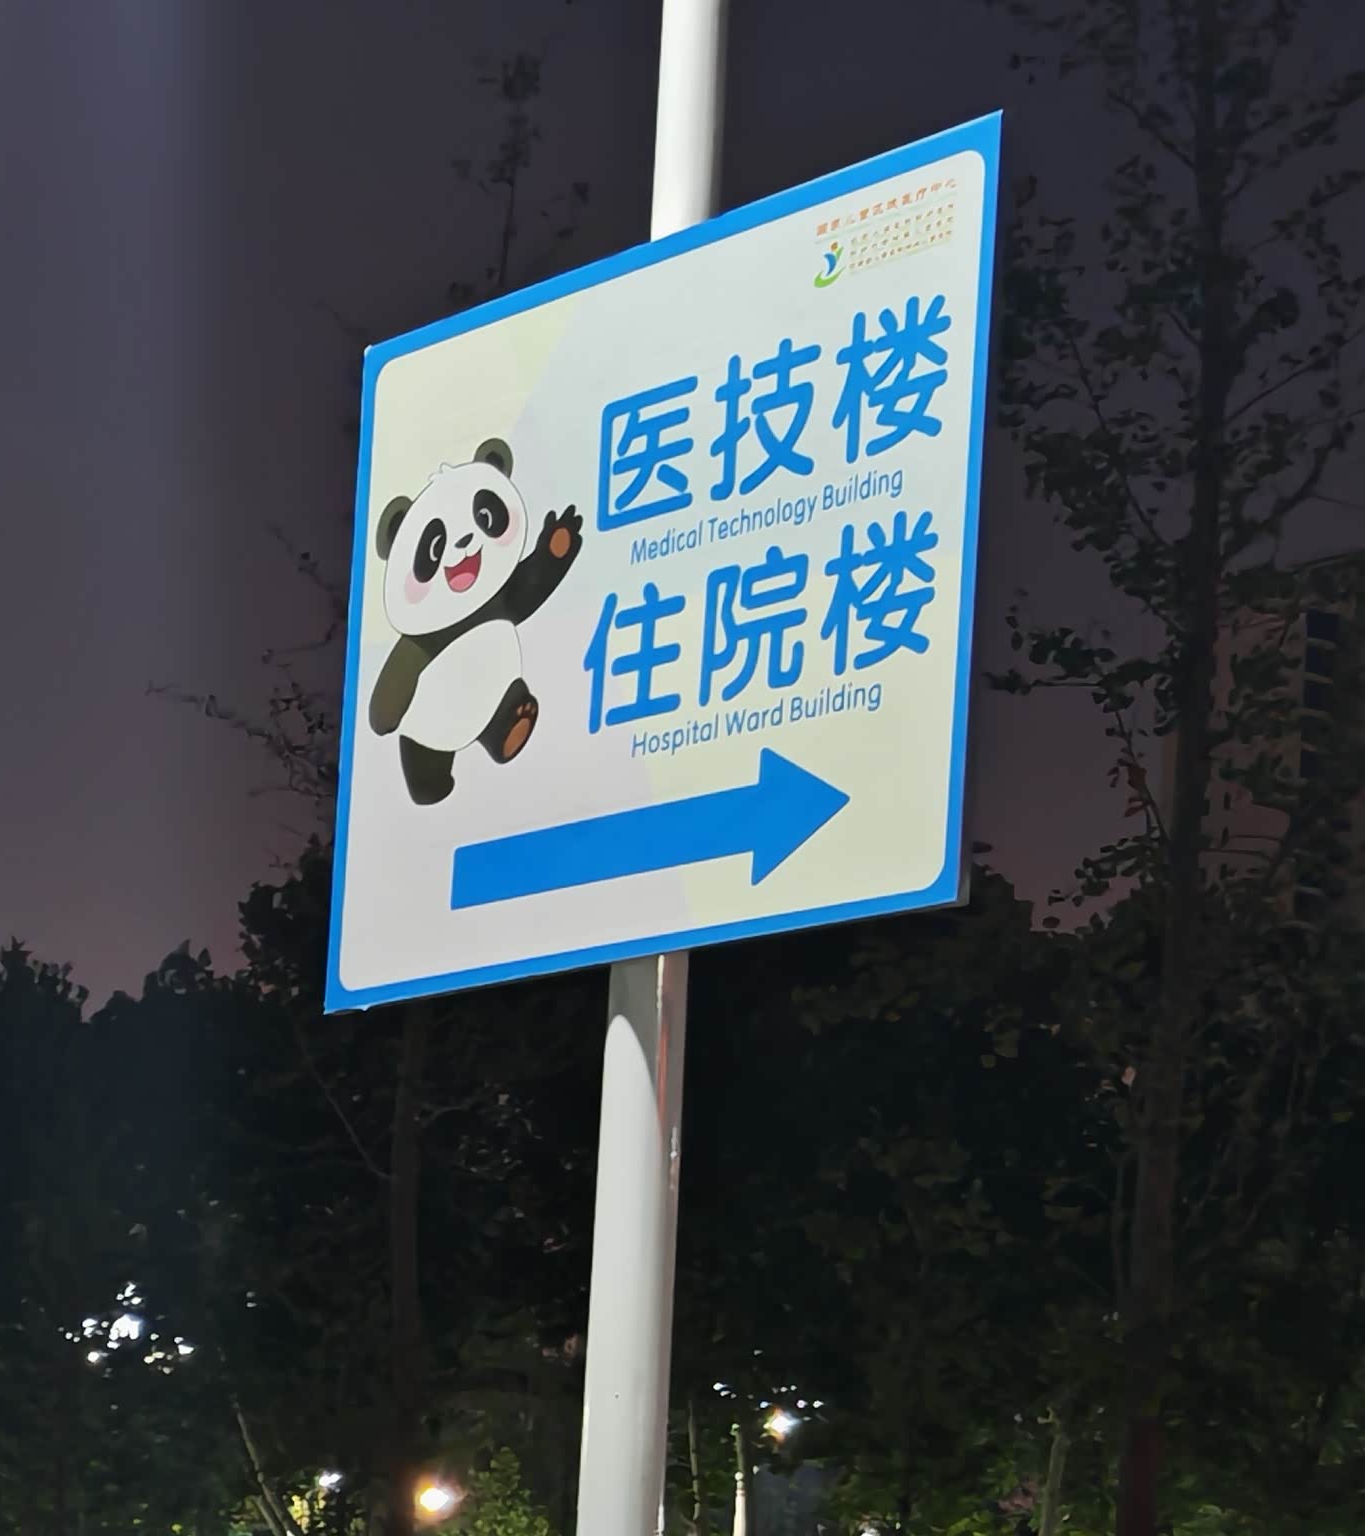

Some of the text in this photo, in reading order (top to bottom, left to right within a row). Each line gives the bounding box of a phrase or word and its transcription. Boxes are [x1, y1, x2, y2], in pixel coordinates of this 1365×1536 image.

[597, 294, 951, 531] 医技楼
[630, 469, 904, 565] Medical Technology Building
[583, 511, 939, 734] 住院楼
[631, 682, 882, 758] Hospital Ward Building
